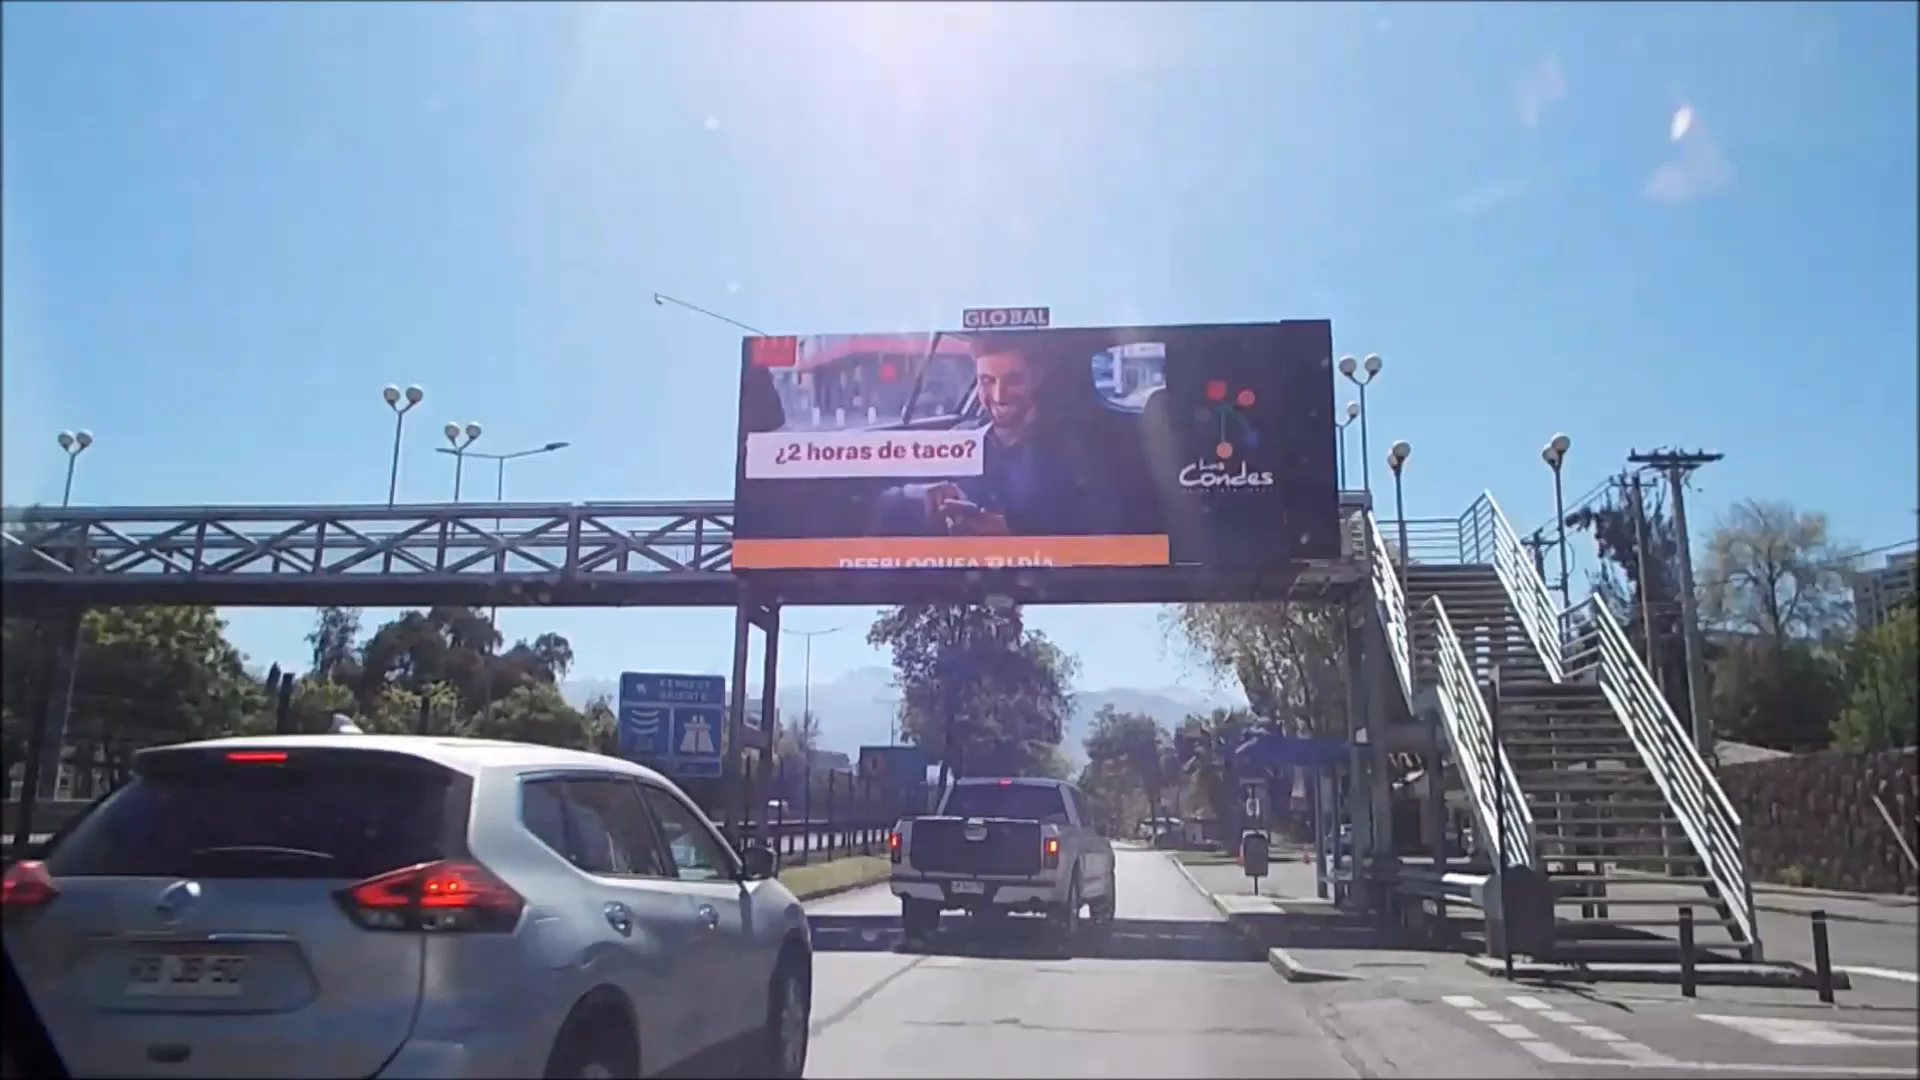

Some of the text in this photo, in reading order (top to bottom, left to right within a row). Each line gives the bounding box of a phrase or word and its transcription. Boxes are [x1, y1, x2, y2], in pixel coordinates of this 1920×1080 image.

[964, 309, 1048, 326] GLOBAL
[775, 439, 977, 465] ¿2 horas de taco?
[1178, 460, 1274, 487] Condes
